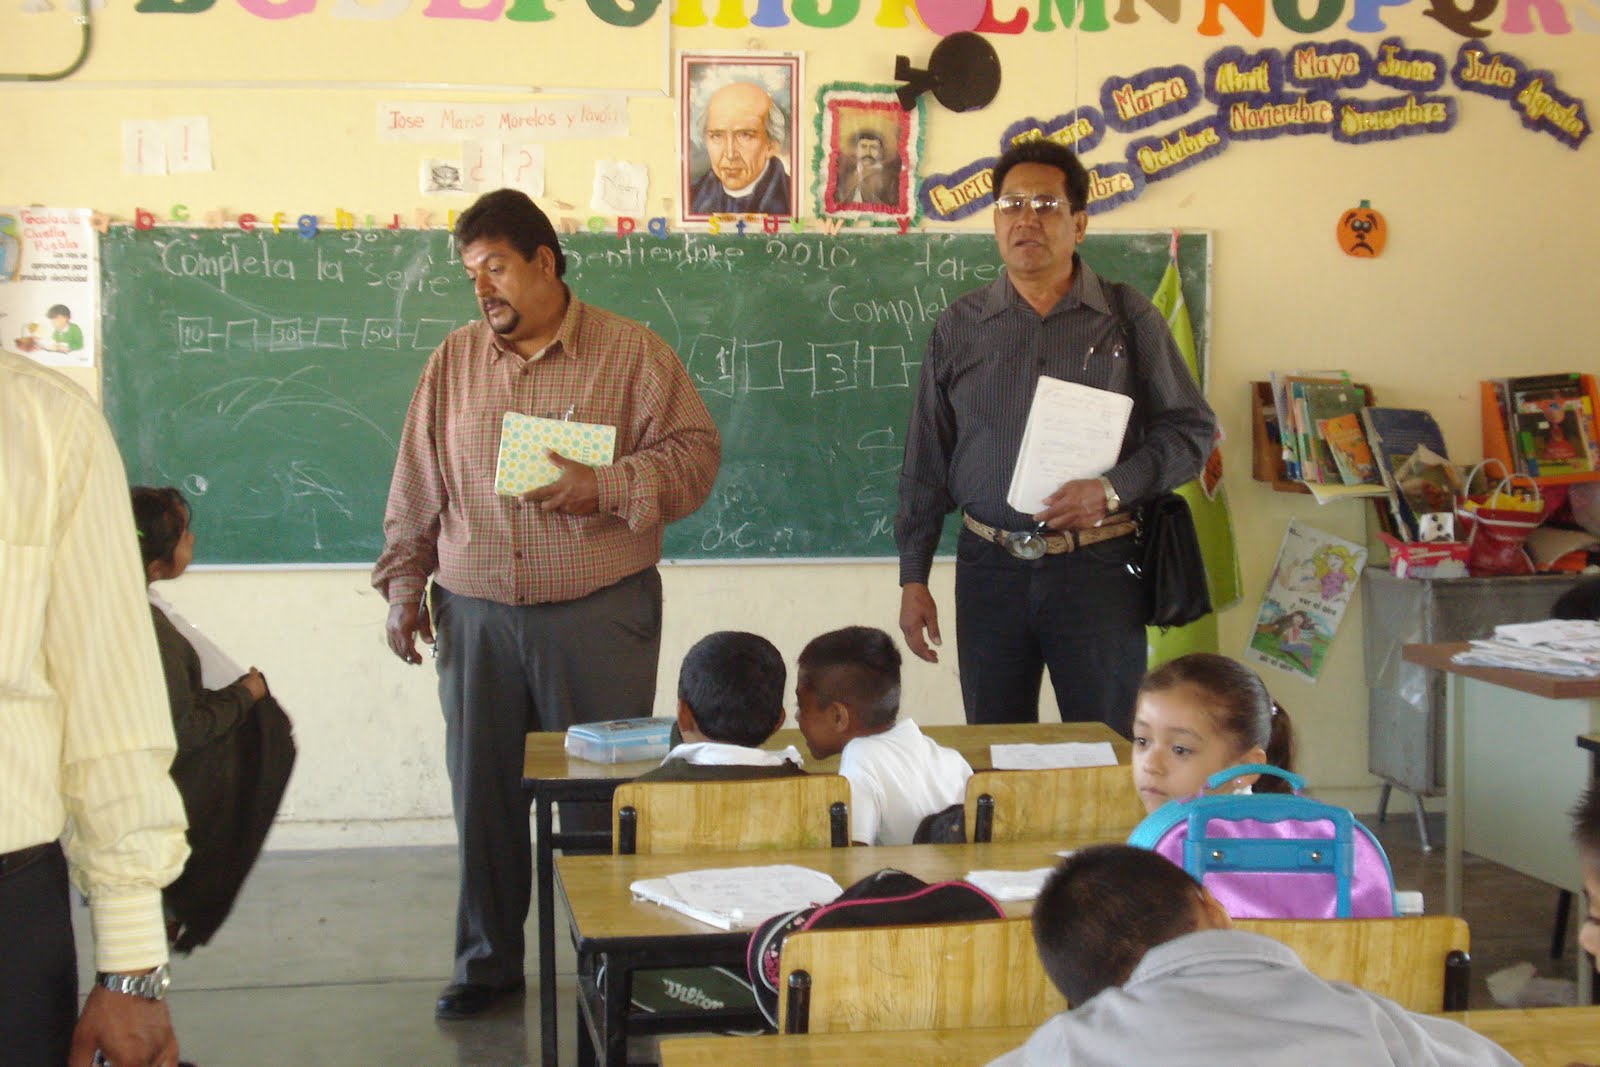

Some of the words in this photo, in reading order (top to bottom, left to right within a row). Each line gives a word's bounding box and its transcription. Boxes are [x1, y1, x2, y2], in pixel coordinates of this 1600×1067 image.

[1217, 61, 1268, 92] Abril
[1296, 47, 1356, 80] Mayo
[1462, 50, 1513, 86] Julio
[1113, 80, 1186, 120] Marzo
[1231, 97, 1330, 129] Noviembre
[1342, 95, 1442, 134] Diciembre
[499, 107, 556, 129] Morelos
[1138, 128, 1217, 173] Octubre
[931, 172, 993, 213] Enero
[135, 207, 155, 231] b
[171, 204, 190, 221] c
[154, 233, 296, 294] Completa
[317, 248, 344, 283] la
[914, 243, 1000, 281] tare
[183, 326, 203, 345] 10
[276, 325, 297, 342] 30
[367, 325, 392, 341] 50
[826, 354, 847, 383] 3
